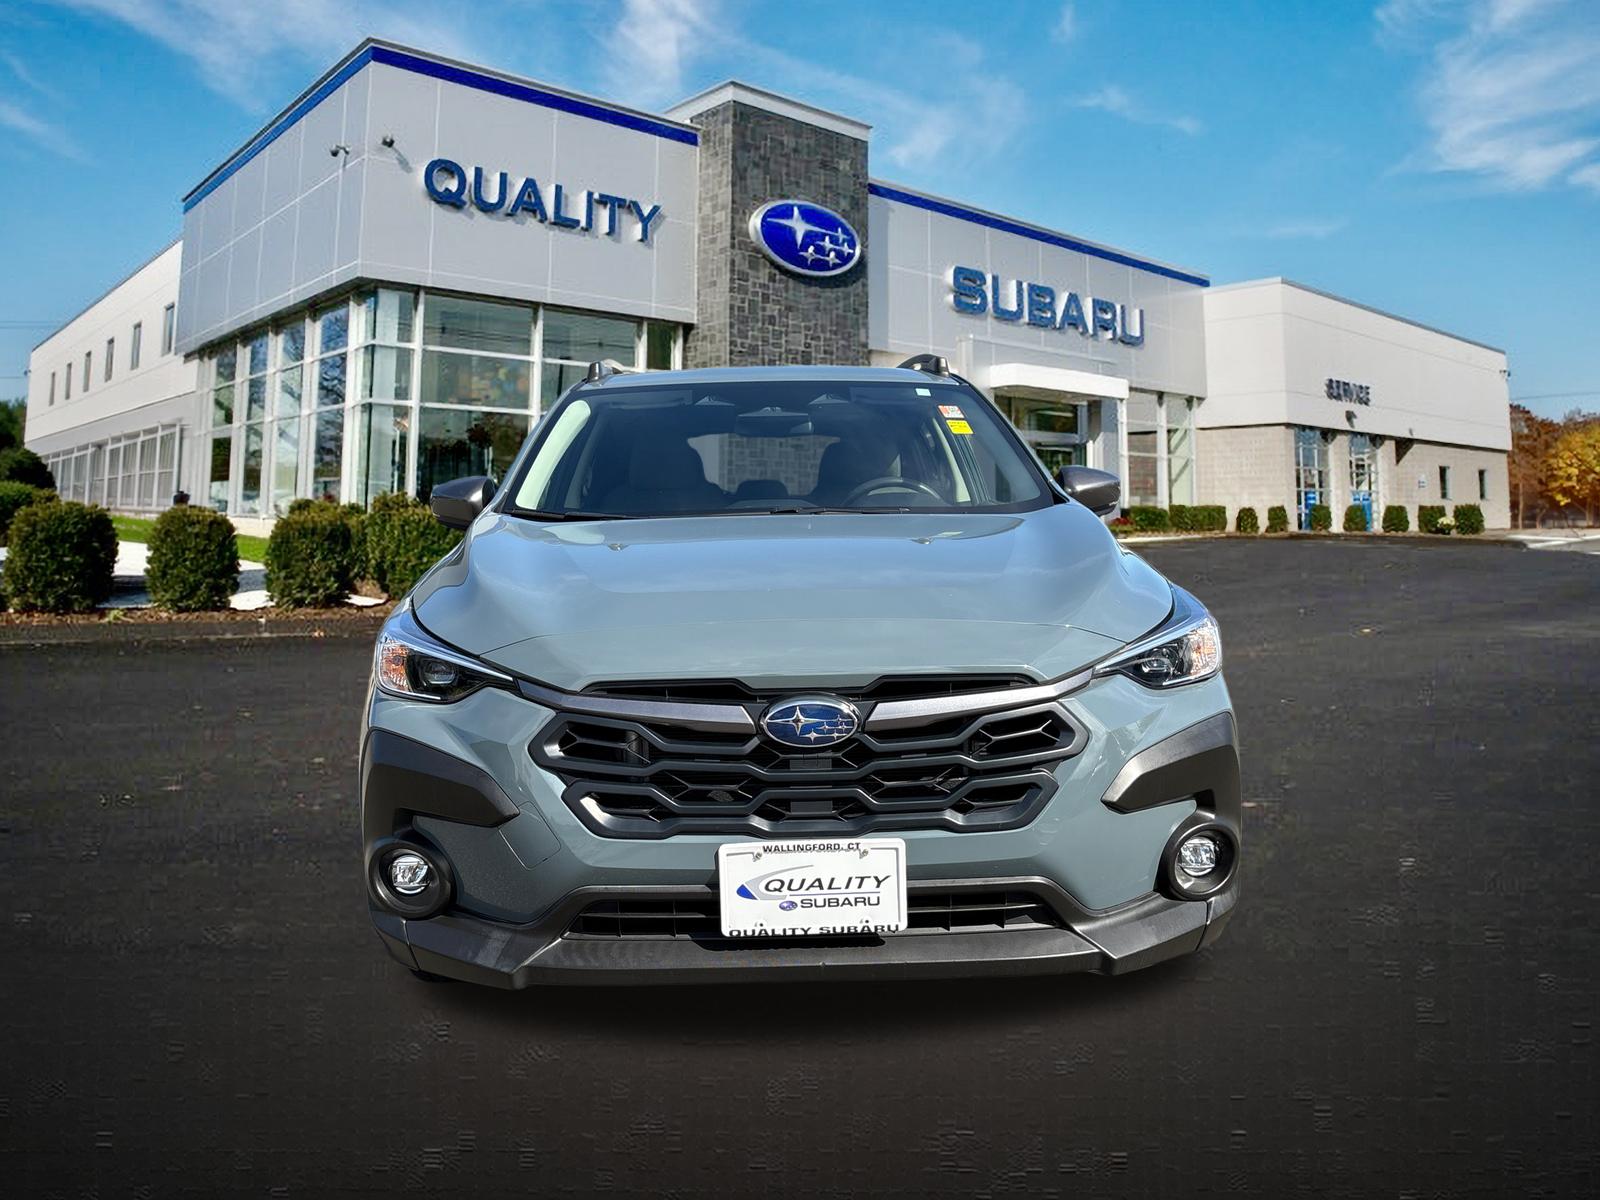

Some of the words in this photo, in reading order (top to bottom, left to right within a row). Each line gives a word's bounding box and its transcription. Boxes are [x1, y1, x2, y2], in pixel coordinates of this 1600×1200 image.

[424, 158, 661, 242] QUALITY
[951, 265, 1145, 346] SUBARU
[1325, 377, 1371, 406] SERVICE
[847, 842, 861, 850] CT
[764, 875, 891, 893] QUALITY
[800, 896, 880, 908] SUBARU
[729, 927, 812, 937] QUALITY
[818, 924, 900, 934] SUBARU
